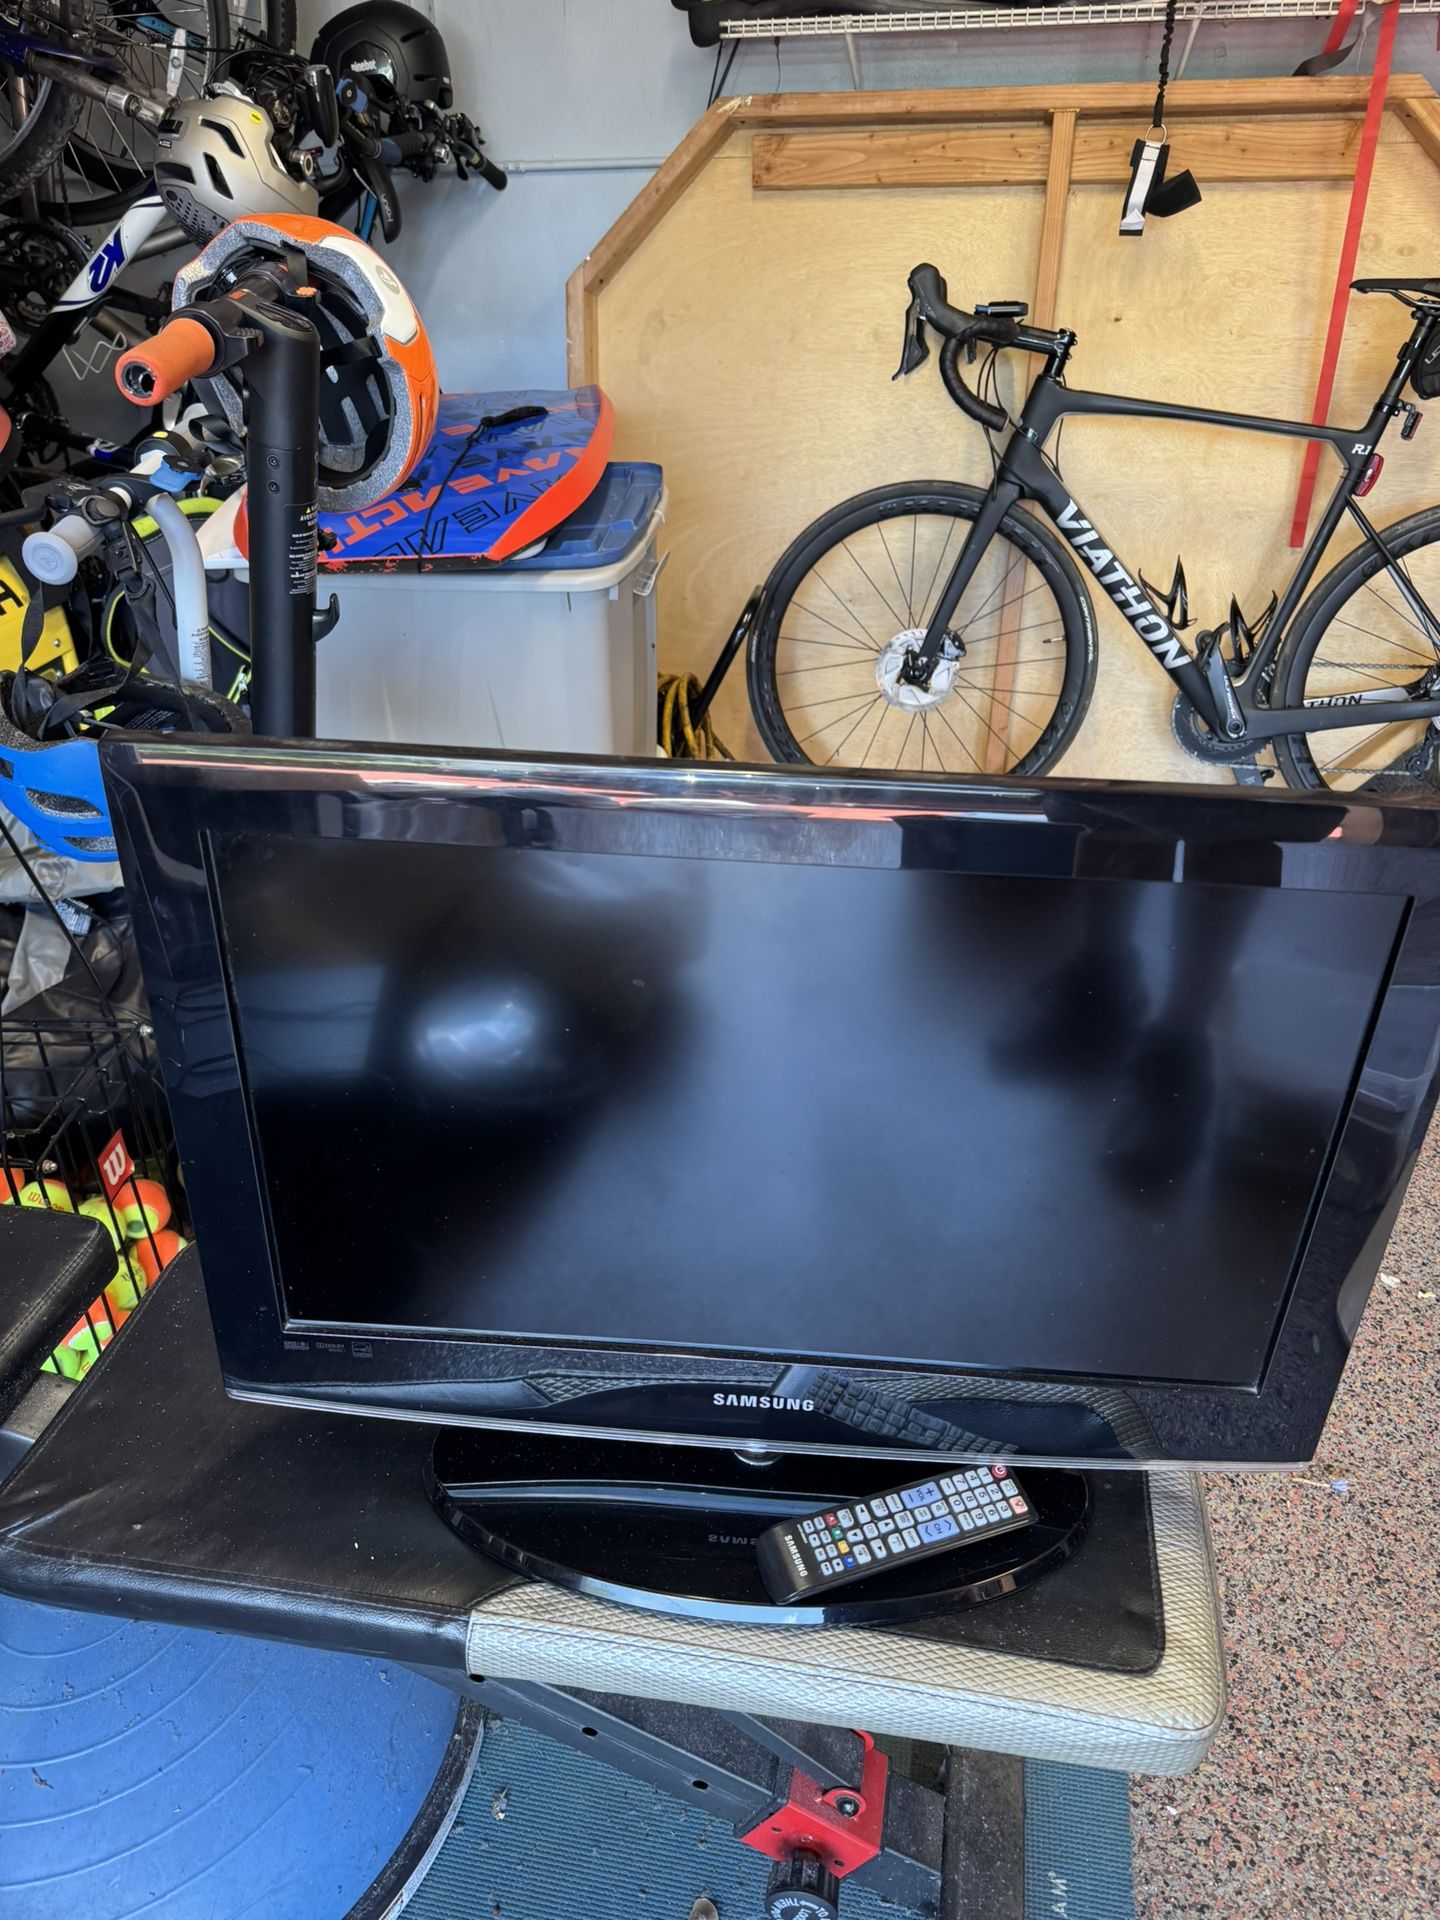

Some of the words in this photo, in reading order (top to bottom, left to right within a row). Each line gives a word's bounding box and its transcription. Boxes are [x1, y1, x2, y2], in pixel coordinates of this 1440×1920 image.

[350, 59, 378, 73] ninebot
[88, 225, 126, 294] K2
[1055, 497, 1193, 670] VIATHON
[1079, 596, 1094, 664] CONTINENTAL
[103, 1143, 126, 1186] W
[712, 1392, 815, 1412] SAMSUNG
[916, 1488, 926, 1503] VOL
[933, 1523, 943, 1535] CH
[783, 1534, 808, 1577] SAMSUNG
